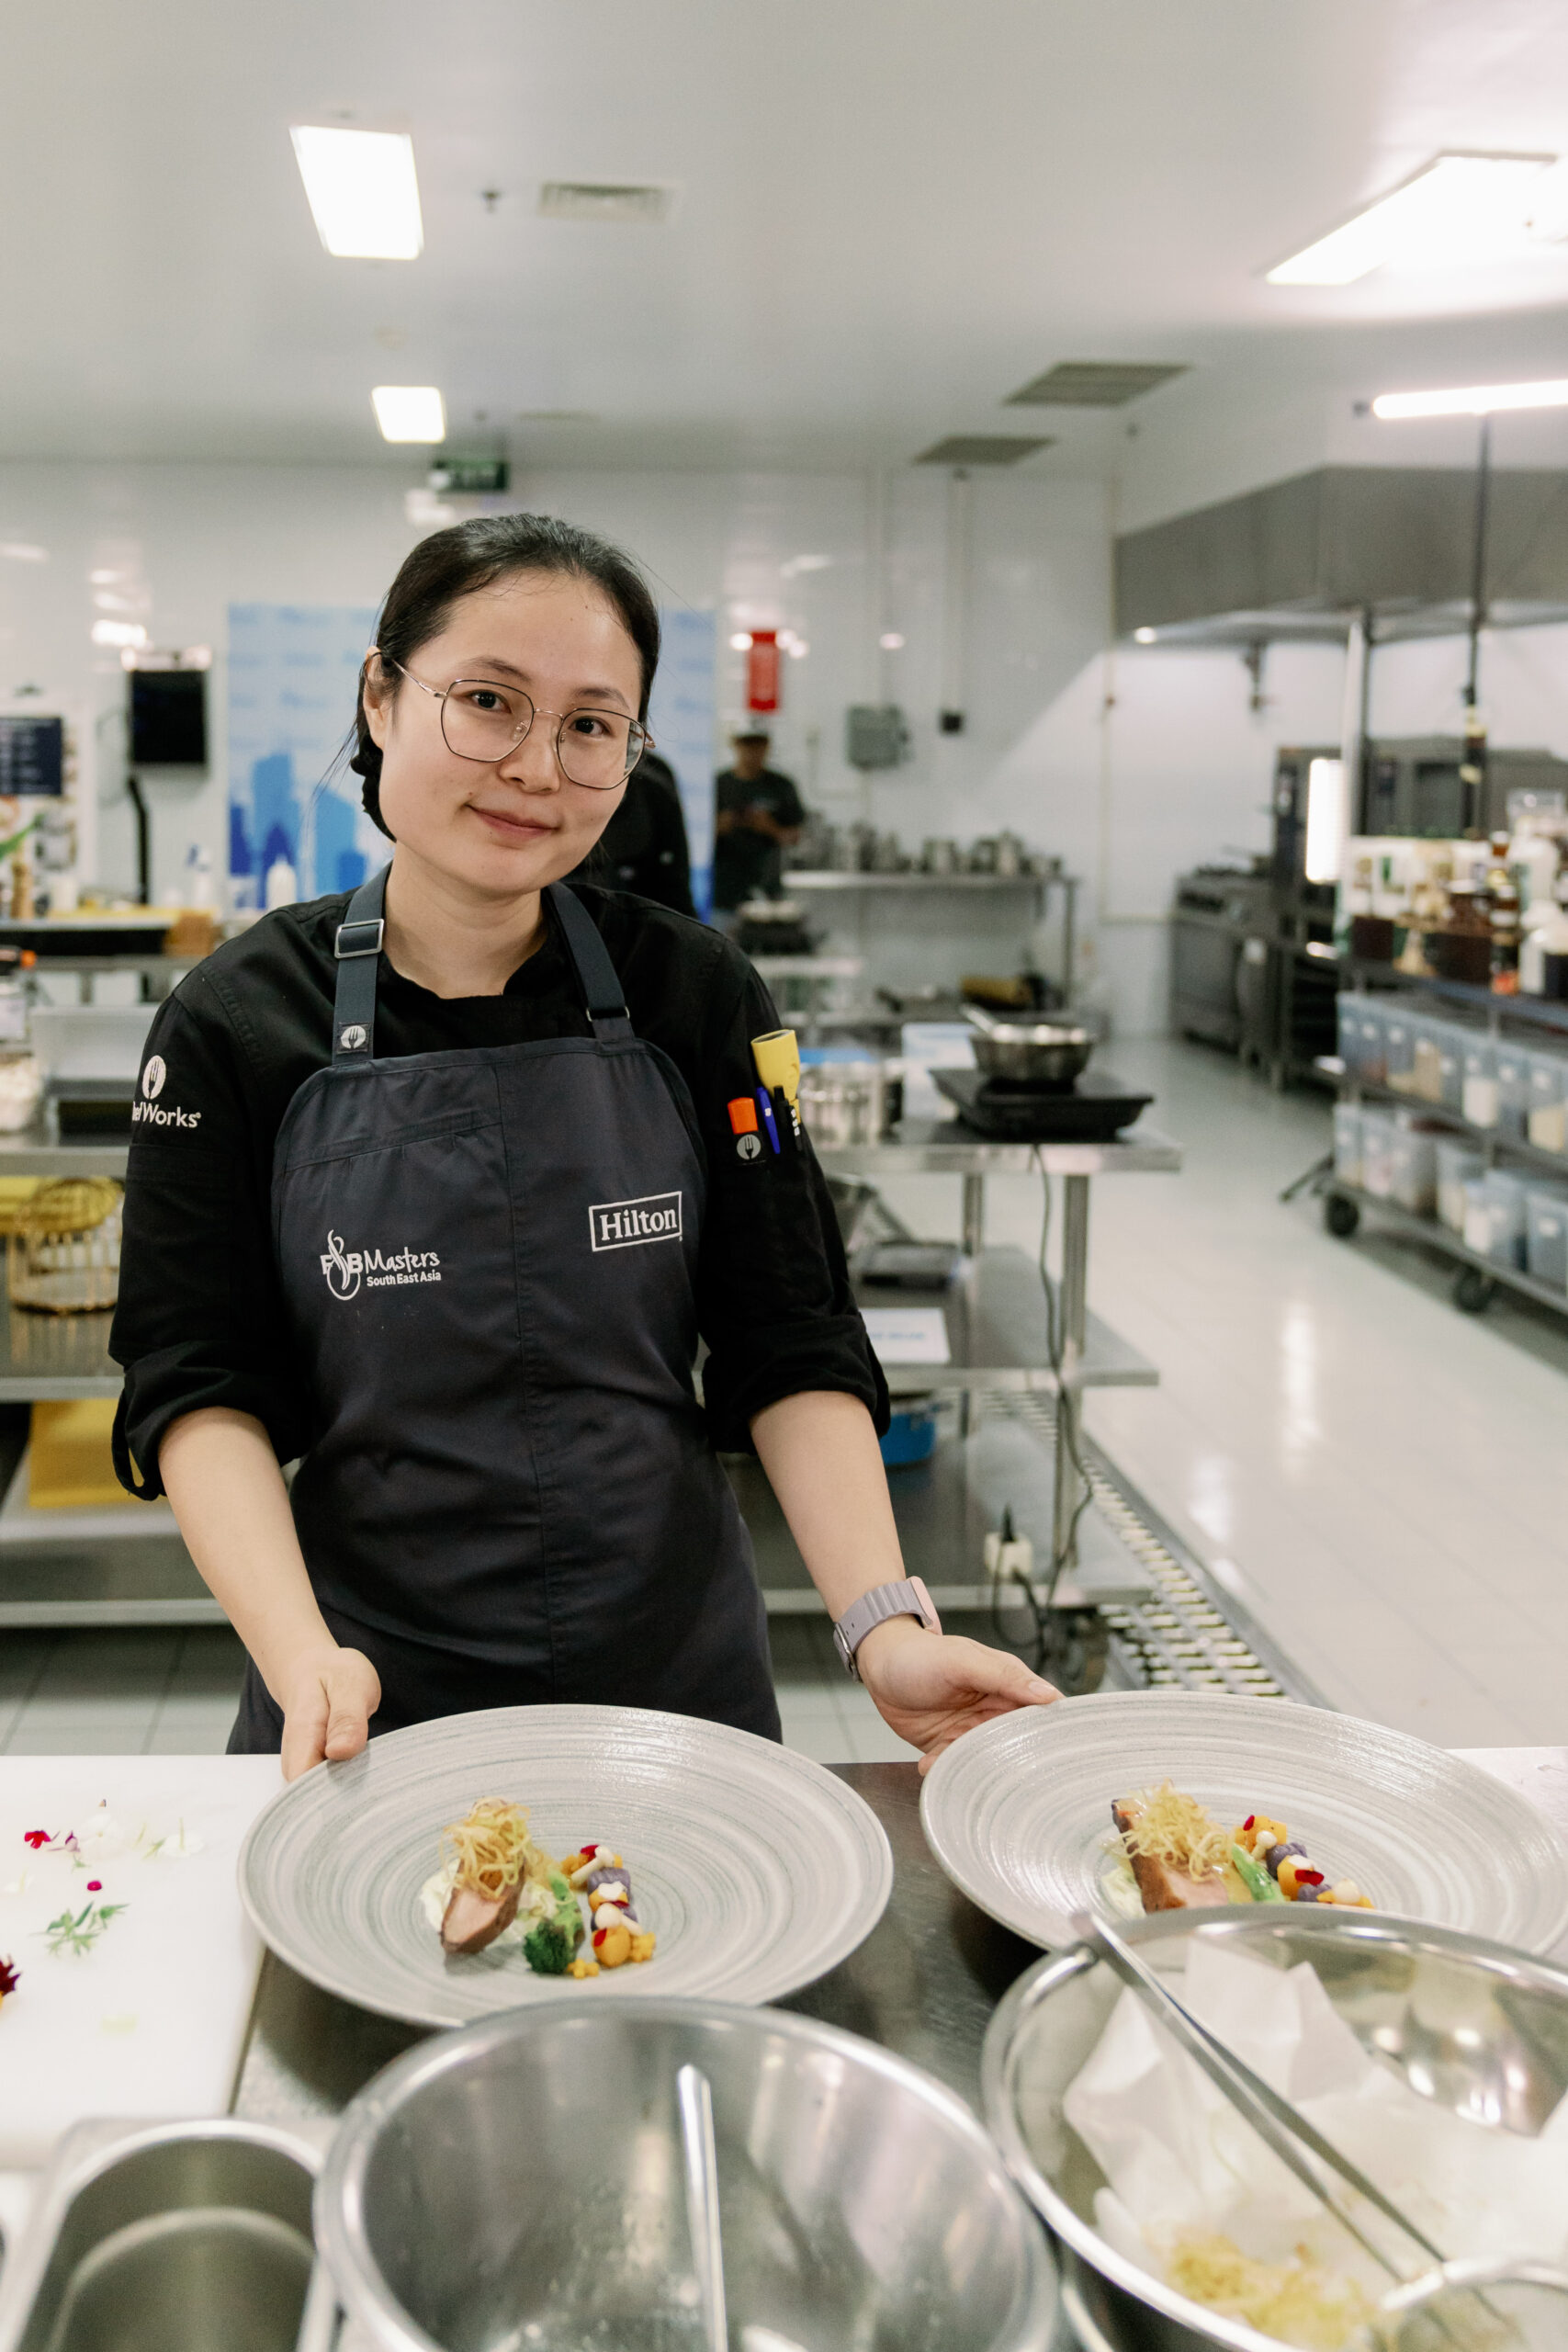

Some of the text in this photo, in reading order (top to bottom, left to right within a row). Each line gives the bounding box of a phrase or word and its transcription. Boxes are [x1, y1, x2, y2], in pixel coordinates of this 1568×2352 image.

[599, 1209, 678, 1241] Hilton
[363, 1246, 441, 1274] Masters
[367, 1269, 442, 1287] South East Asia
